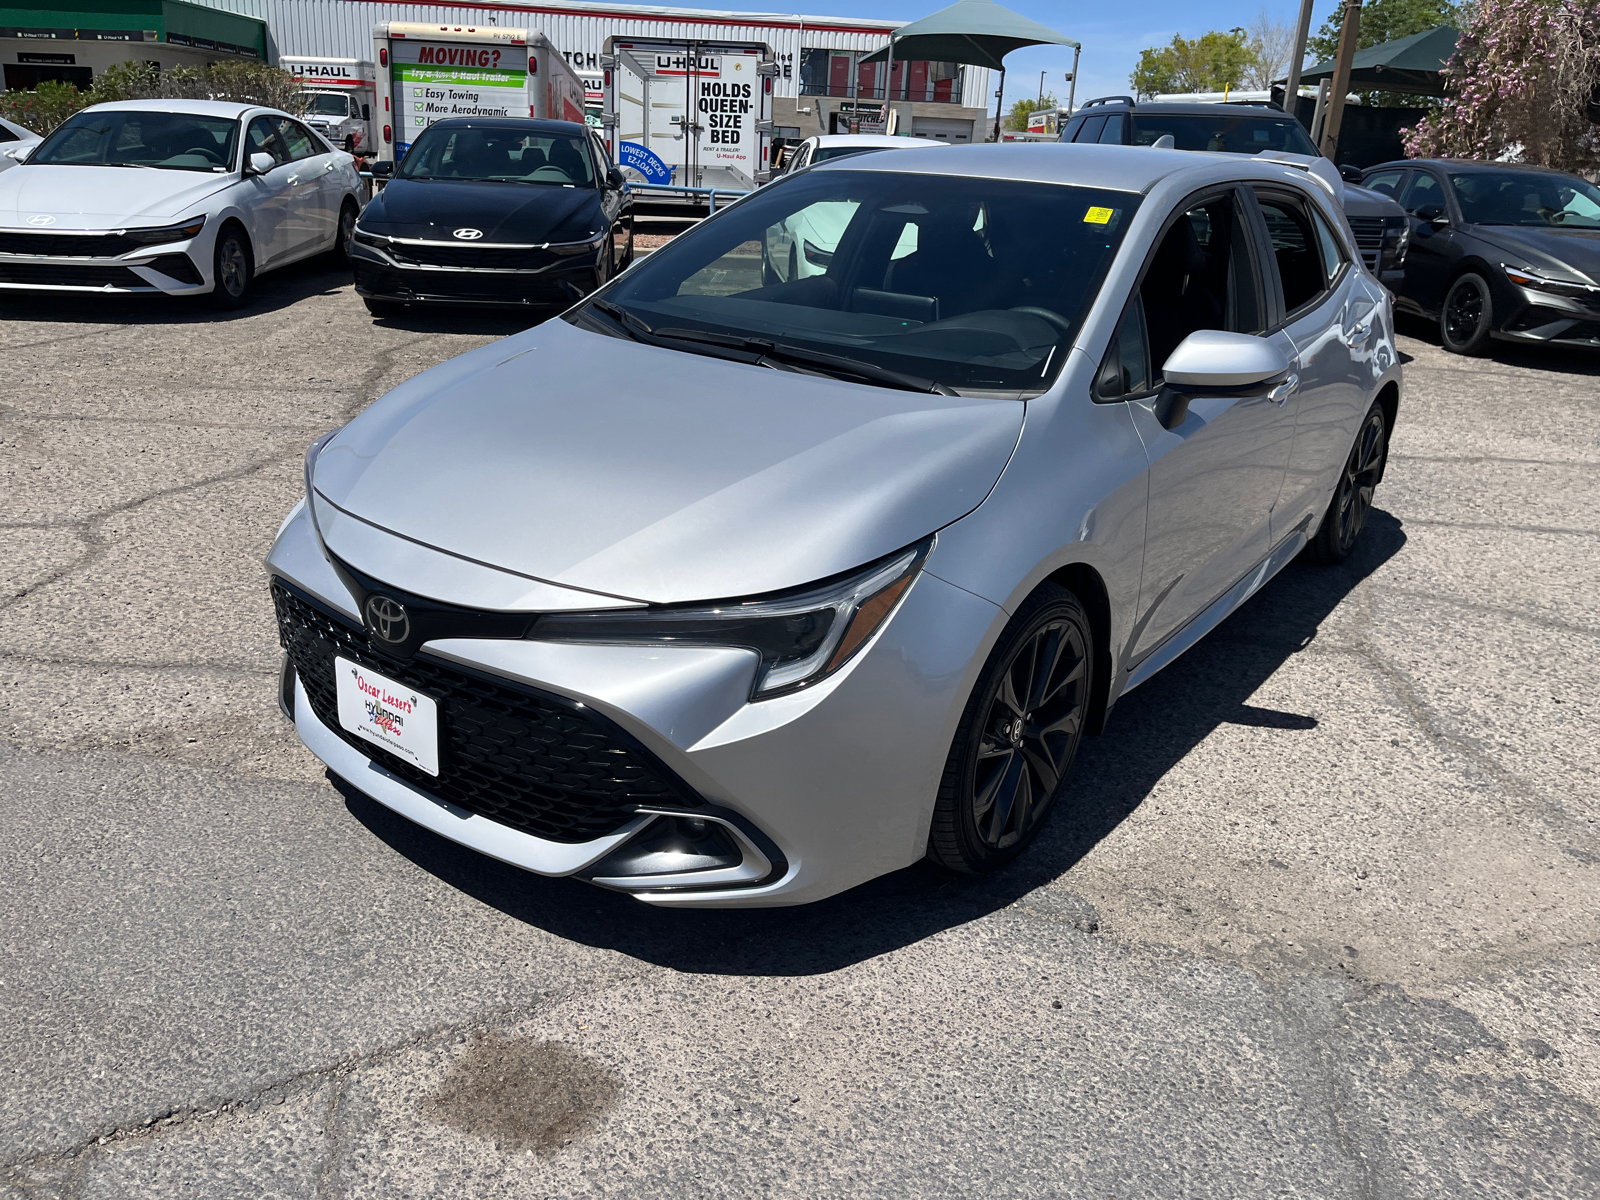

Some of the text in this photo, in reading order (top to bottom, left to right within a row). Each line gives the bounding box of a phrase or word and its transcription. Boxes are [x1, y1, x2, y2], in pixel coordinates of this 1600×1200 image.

[418, 46, 501, 68] MOVING?
[656, 55, 719, 70] U-HAUL
[290, 65, 350, 77] U-HAUL
[411, 68, 425, 80] Try
[426, 70, 432, 78] a
[482, 72, 510, 82] Trailer
[425, 88, 479, 103] Easy Towing
[701, 82, 751, 98] HOLDS
[425, 102, 508, 116] More Aerodynamic
[698, 98, 753, 114] QUEEN-
[709, 114, 742, 129] SIZE
[711, 130, 740, 144] BED
[621, 145, 665, 177] LOWEST DECKS
[627, 155, 653, 175] EZ-LOAD
[357, 675, 411, 714] Oscar Leeser's
[365, 700, 403, 726] HYUNDAI
[384, 719, 401, 736] Paso
